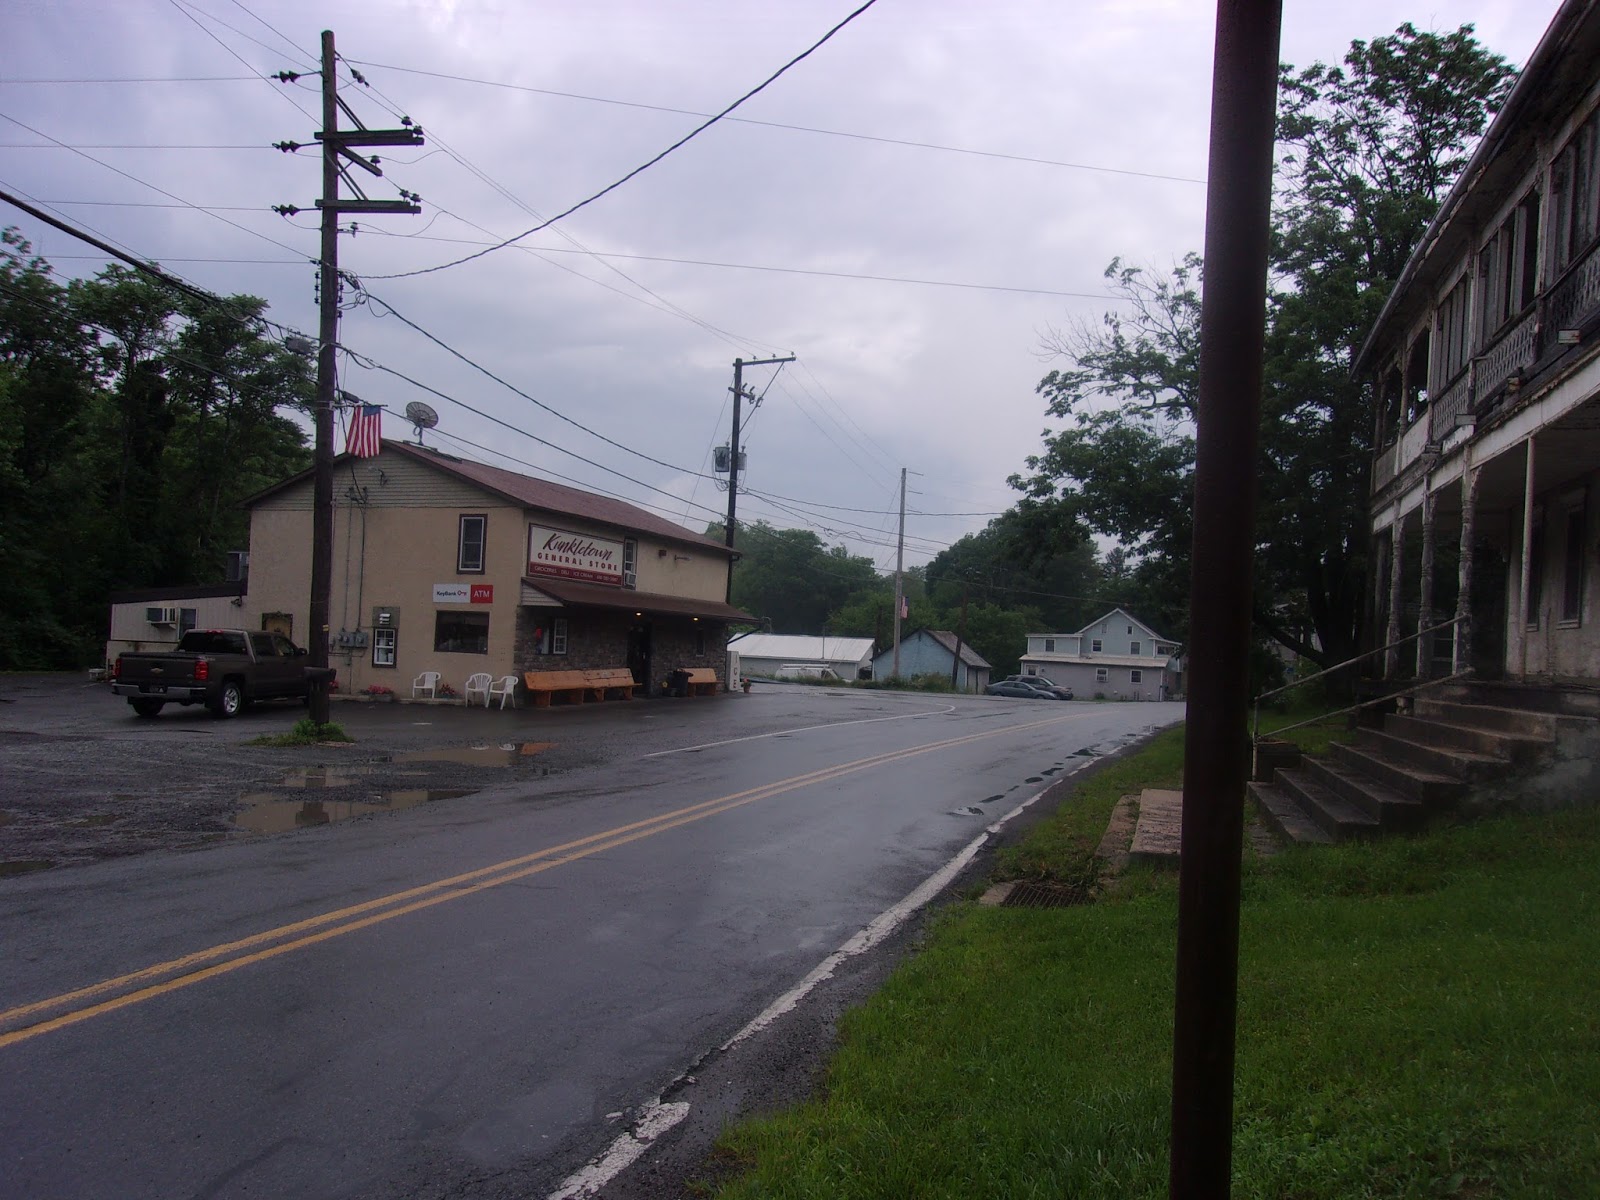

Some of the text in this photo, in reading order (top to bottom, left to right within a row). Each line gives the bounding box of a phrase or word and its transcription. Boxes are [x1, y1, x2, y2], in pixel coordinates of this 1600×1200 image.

[543, 533, 613, 560] Kunkletown
[537, 552, 618, 571] GENERAL STORE
[473, 590, 490, 598] ATM
